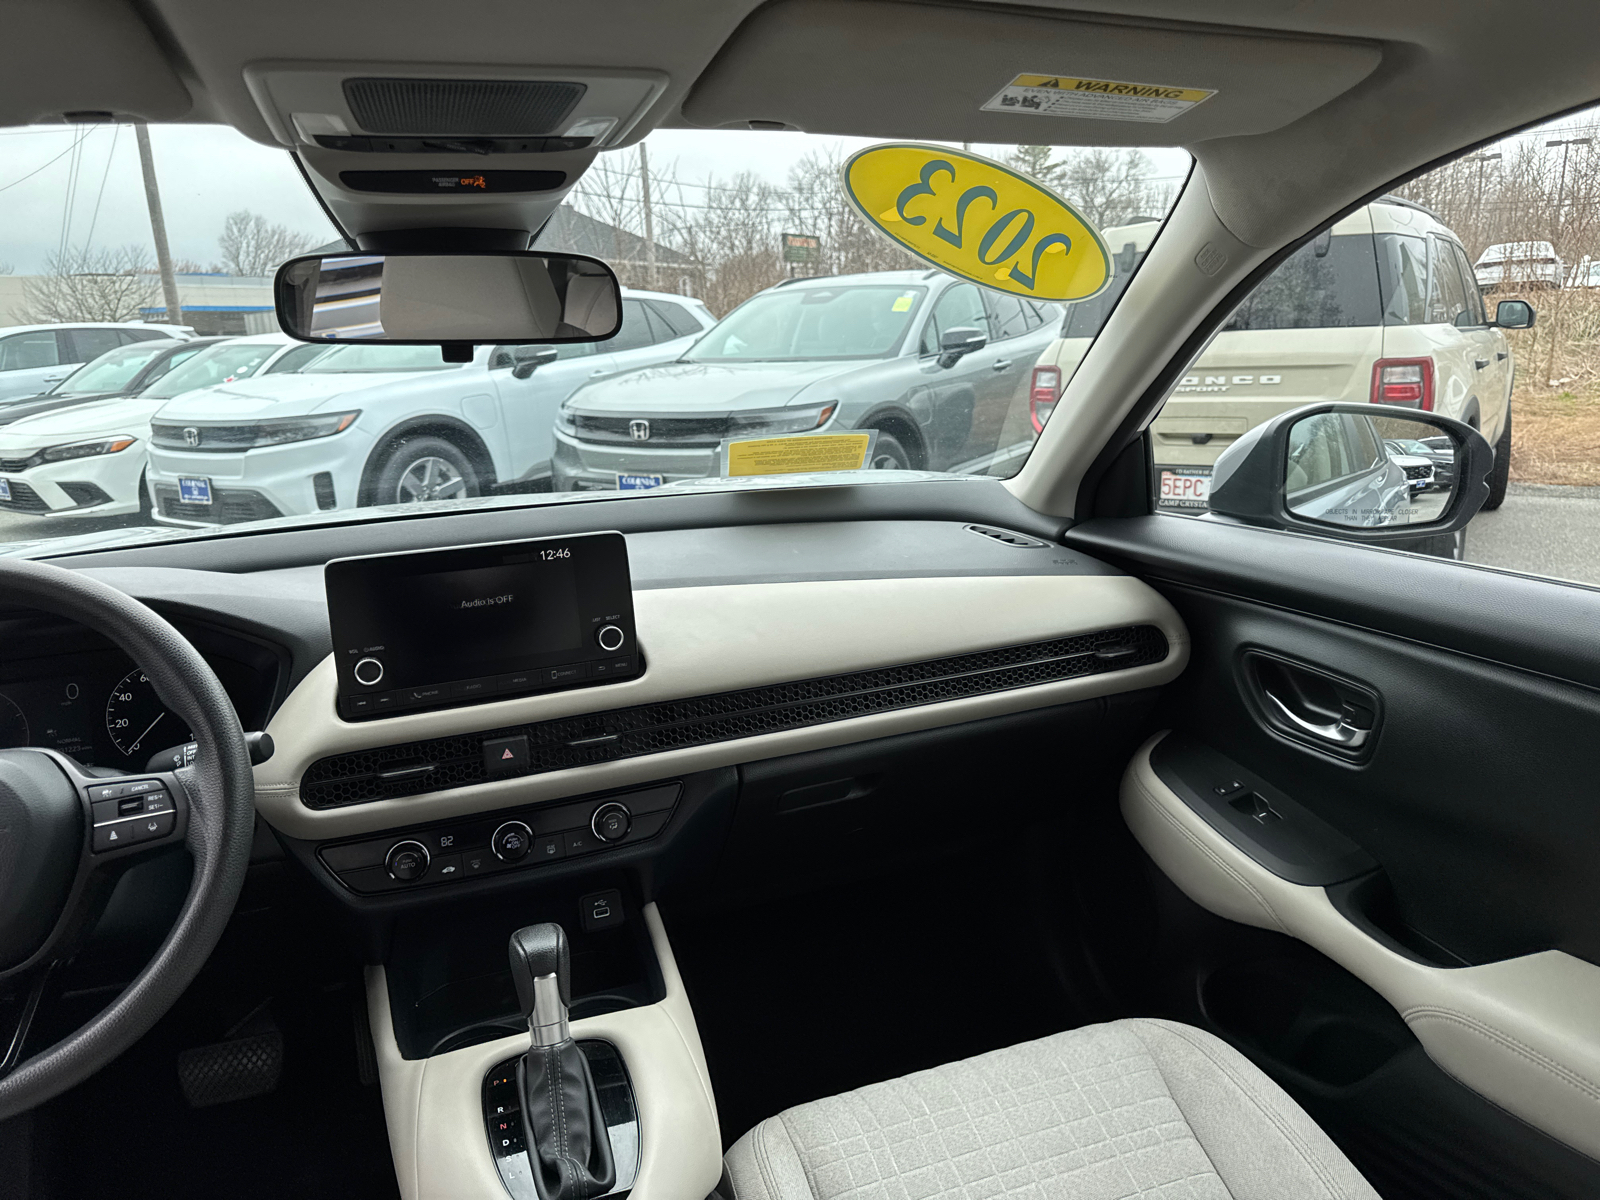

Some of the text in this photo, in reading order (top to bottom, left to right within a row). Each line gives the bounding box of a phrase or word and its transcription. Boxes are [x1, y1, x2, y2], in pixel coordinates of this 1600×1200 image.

[1074, 80, 1184, 99] WARNING
[1162, 477, 1204, 497] 5EPC
[540, 547, 571, 560] 12:46
[461, 600, 486, 609] Audio
[495, 594, 513, 604] OFF
[139, 674, 150, 683] 6
[66, 682, 80, 700] 0
[119, 692, 132, 702] 40
[115, 718, 129, 728] 20
[440, 835, 454, 847] 82
[400, 861, 416, 869] AUTO
[499, 1122, 507, 1130] N
[502, 1139, 510, 1147] D
[505, 1155, 512, 1163] S
